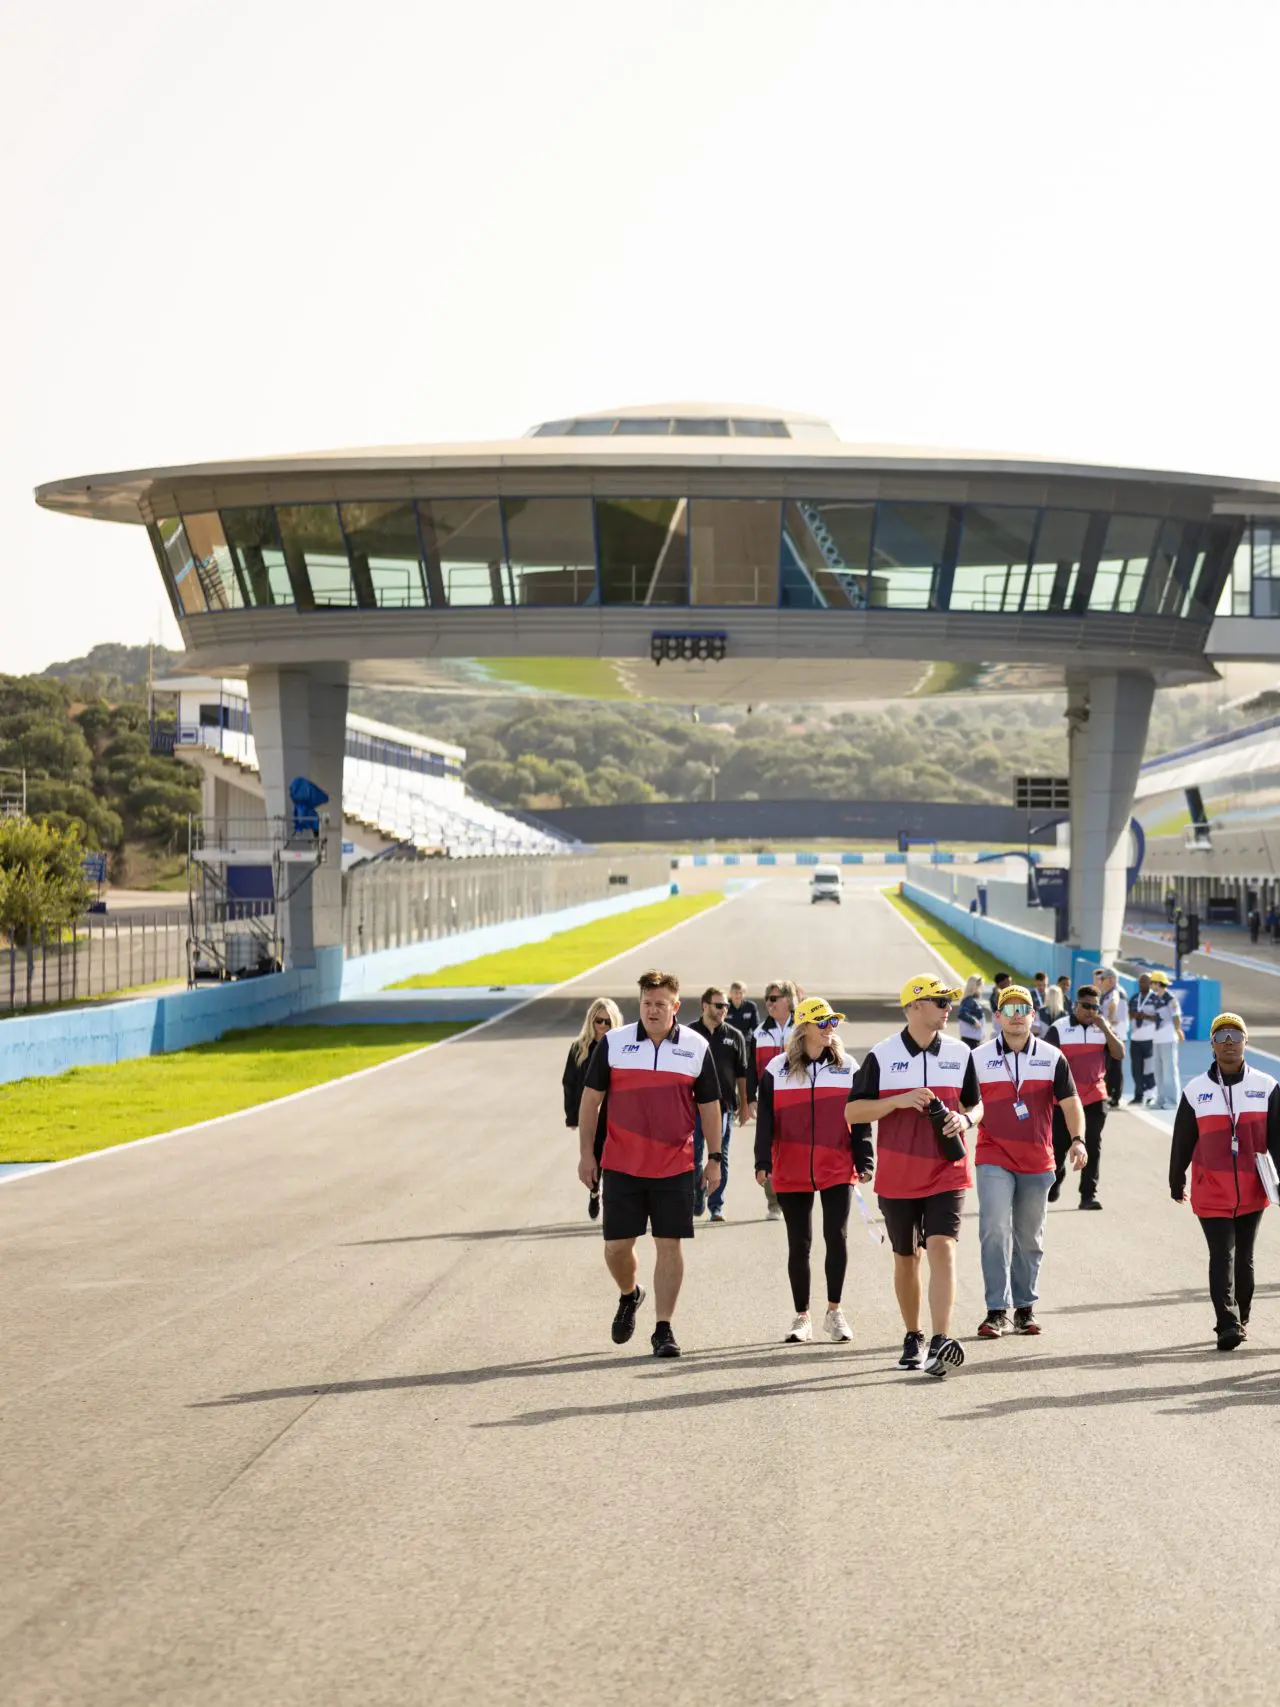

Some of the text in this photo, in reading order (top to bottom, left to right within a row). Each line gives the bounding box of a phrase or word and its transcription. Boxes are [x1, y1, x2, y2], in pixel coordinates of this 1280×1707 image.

[621, 1044, 640, 1052] FIM
[890, 1061, 909, 1070] FIM
[1197, 1093, 1213, 1101] FIM
